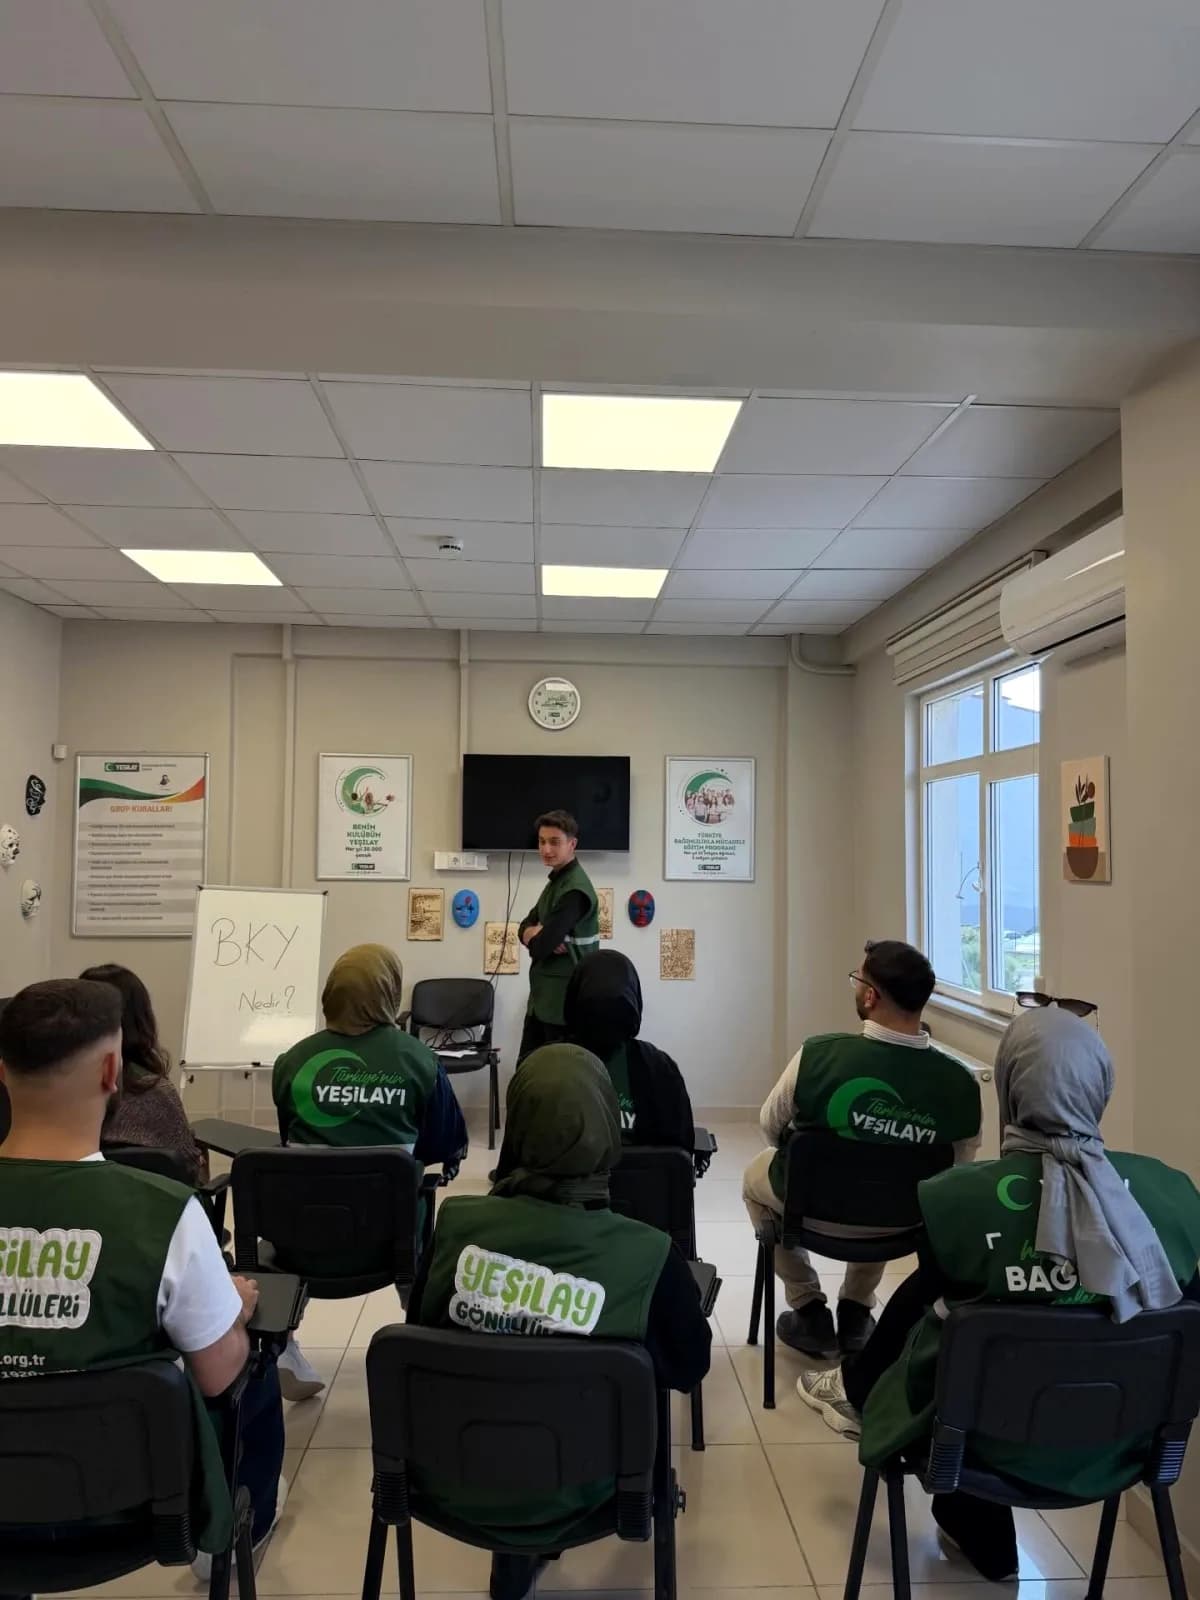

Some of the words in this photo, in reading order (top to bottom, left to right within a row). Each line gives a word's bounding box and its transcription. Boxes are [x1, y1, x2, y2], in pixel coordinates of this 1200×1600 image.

[211, 917, 299, 970] BKY
[462, 1254, 597, 1327] YEŞİLAY
[0, 1354, 46, 1368] .org.tr
